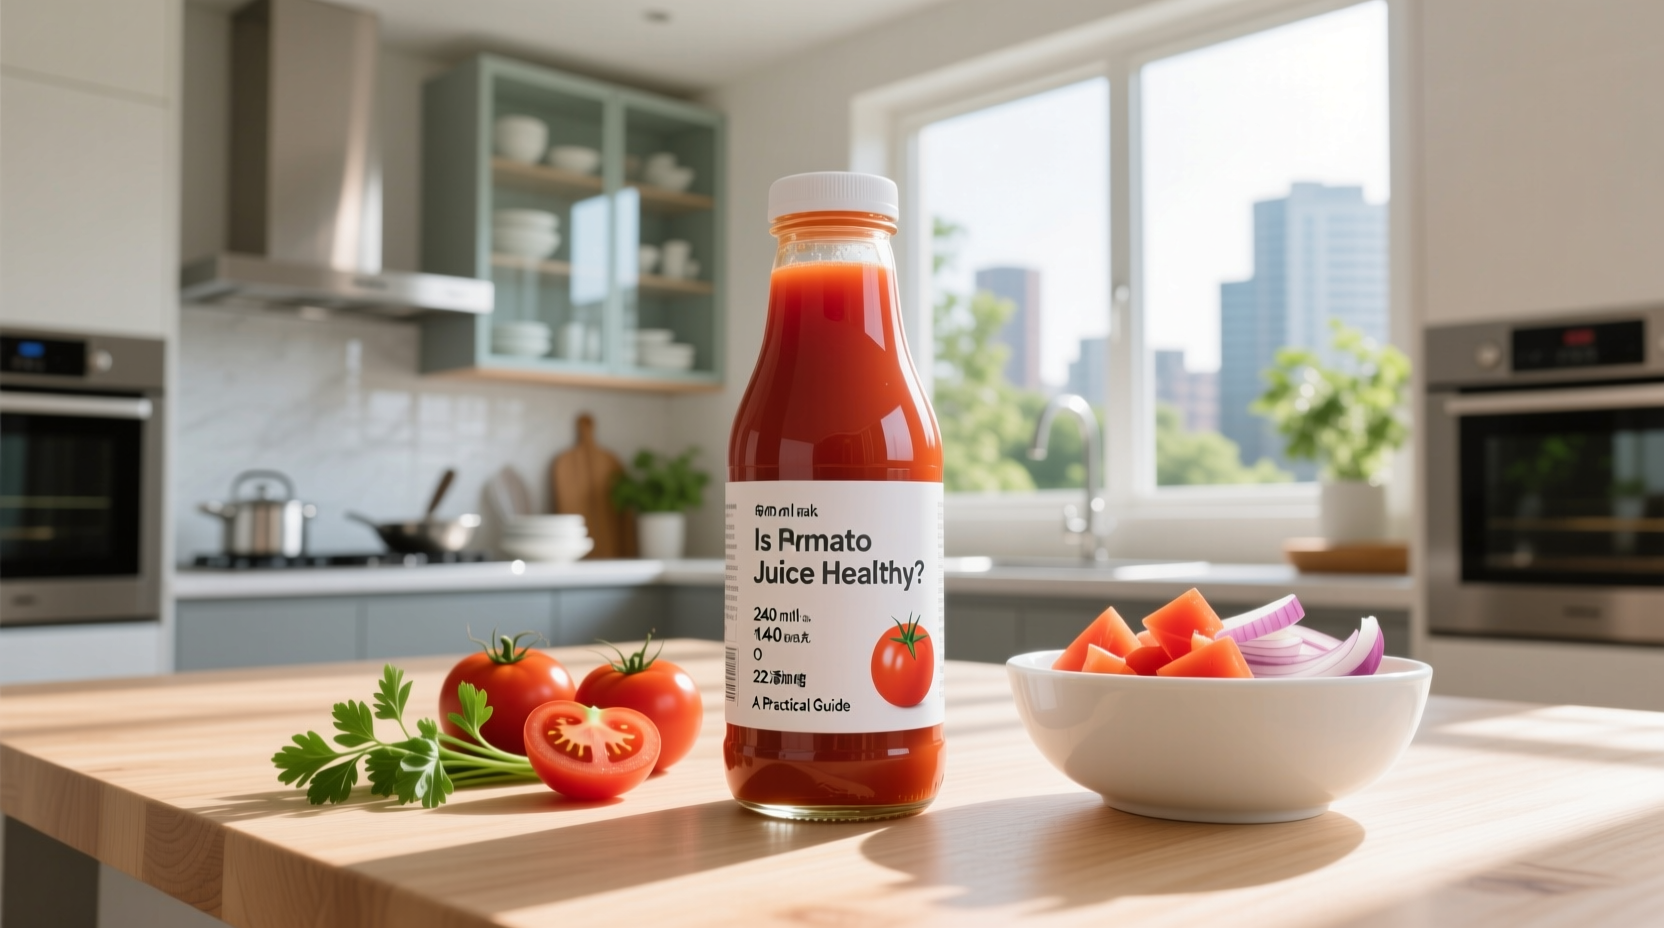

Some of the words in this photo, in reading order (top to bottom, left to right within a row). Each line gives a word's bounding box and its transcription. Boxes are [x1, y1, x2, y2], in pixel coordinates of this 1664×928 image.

[755, 527, 772, 552] Is
[753, 559, 815, 585] Juice
[822, 559, 925, 592] Healthy?
[753, 606, 778, 622] 240
[754, 626, 782, 643] 140
[751, 695, 761, 711] A
[762, 696, 811, 713] Practical
[813, 697, 851, 713] Guide
